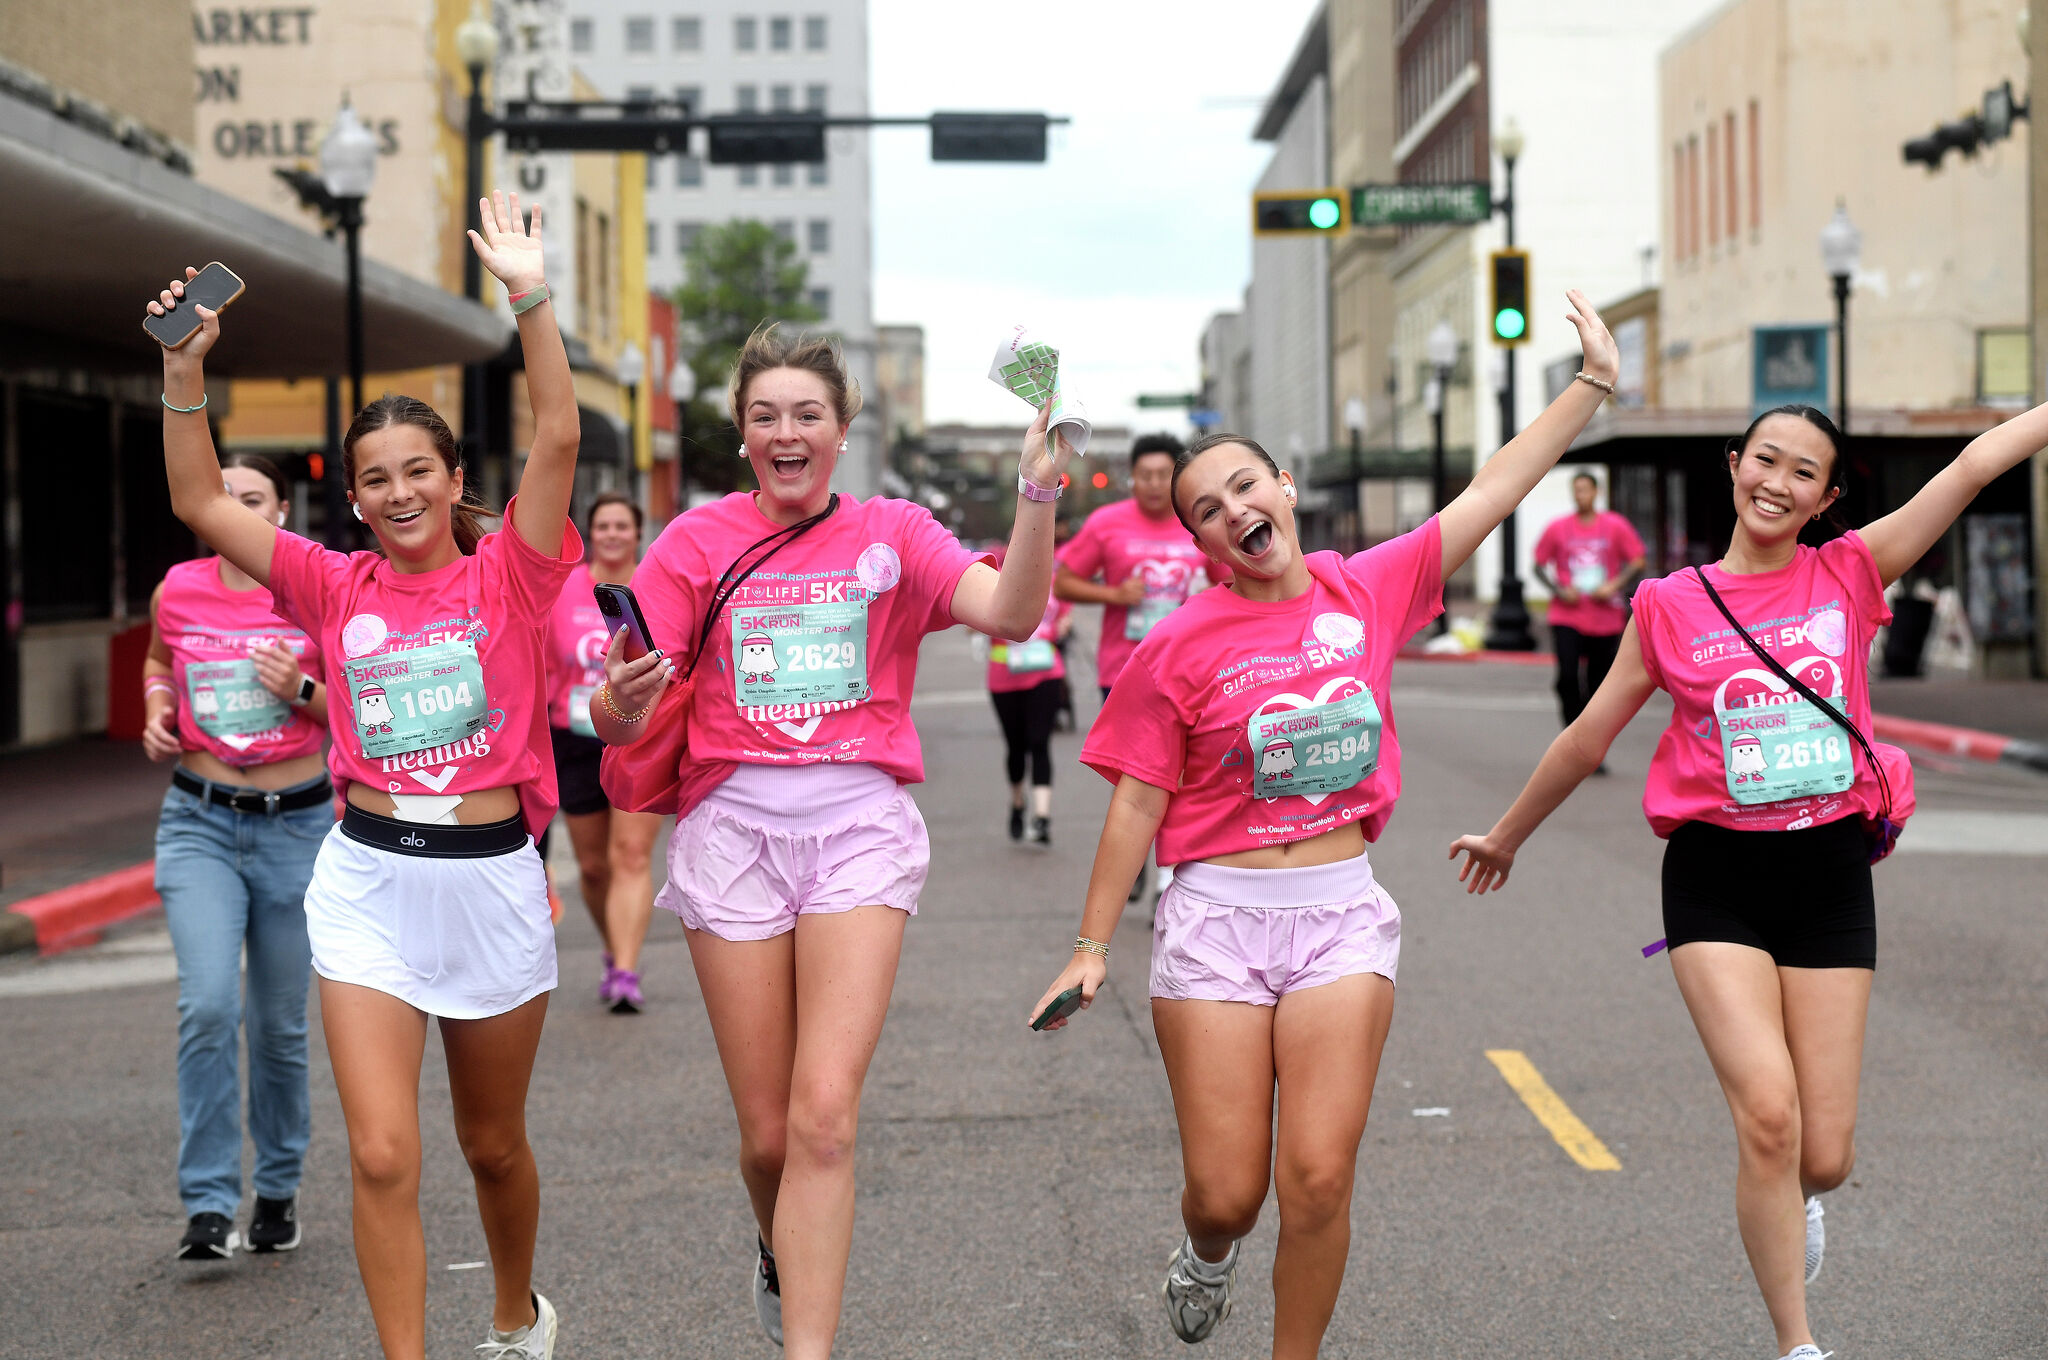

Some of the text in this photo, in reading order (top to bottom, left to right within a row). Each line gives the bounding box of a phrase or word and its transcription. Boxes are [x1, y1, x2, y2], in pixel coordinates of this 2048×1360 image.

[213, 117, 400, 159] ORLES
[1363, 186, 1476, 214] FORSYTHE
[749, 571, 829, 582] RICHARDSON
[715, 586, 750, 600] GFT
[766, 586, 800, 598] LIFE
[810, 581, 845, 603] 5K
[740, 616, 768, 630] 5K
[769, 618, 800, 629] RUN
[773, 625, 851, 637] MONSTER DASH
[786, 641, 856, 672] 2629
[1692, 643, 1725, 662] GIFT
[354, 665, 379, 683] 5K
[377, 660, 408, 669] RIBBON
[378, 665, 409, 679] RUN
[384, 665, 461, 686] MONSTER DASH
[1217, 660, 1249, 679] JULIE
[1222, 669, 1255, 695] GIFT
[1270, 660, 1302, 676] LIFE
[1306, 646, 1344, 669] 5K
[400, 681, 474, 718] 1604
[1259, 721, 1288, 739] 5K
[1288, 719, 1319, 733] RUN
[1293, 716, 1367, 740] MONSTER DASH
[1727, 717, 1755, 732] 5K
[1755, 717, 1786, 729] RUN
[1760, 724, 1808, 738] MONSTER
[382, 729, 491, 773] Healing
[1305, 729, 1371, 767] 2594
[1774, 735, 1841, 770] 2618
[1267, 823, 1295, 835] Dauphin
[1301, 815, 1336, 831] ExxonMobil
[400, 831, 426, 847] alo
[1262, 838, 1289, 846] PROVOST
